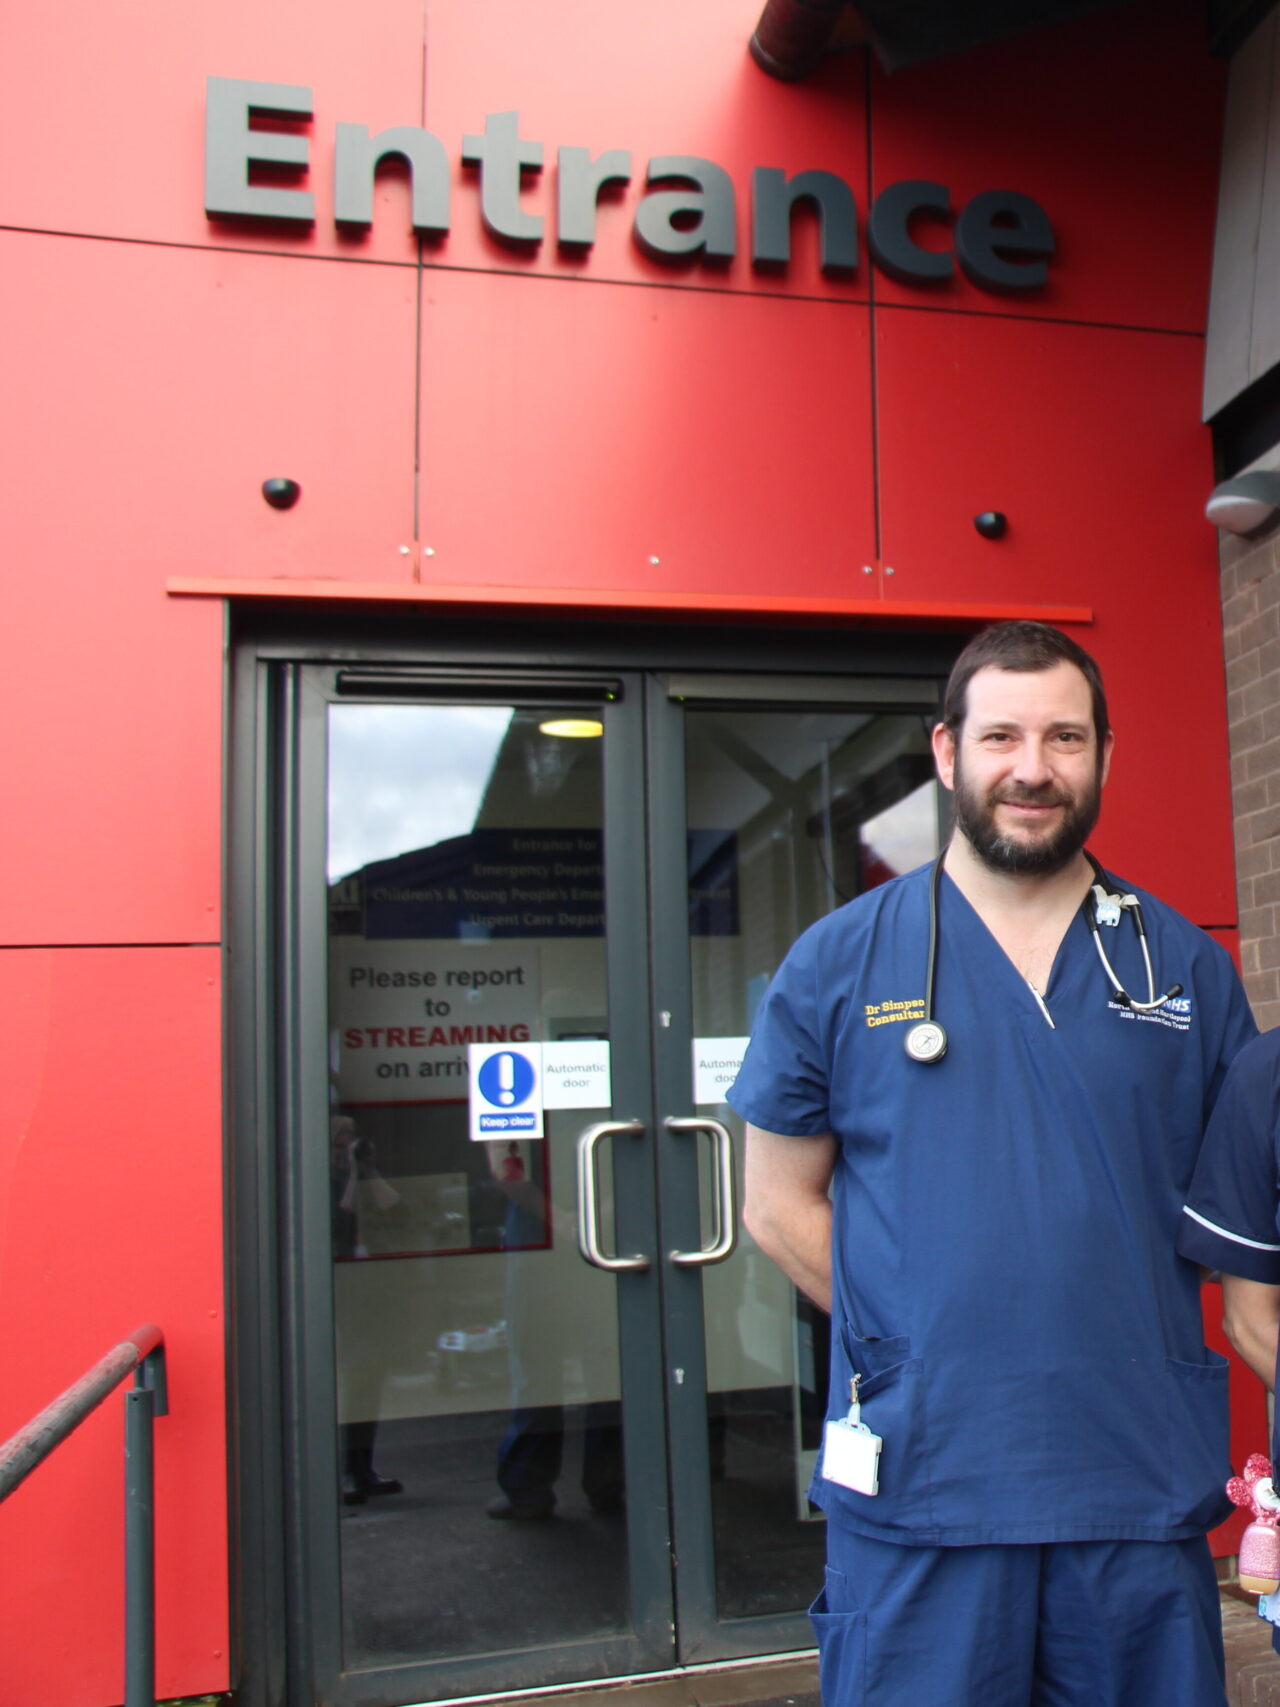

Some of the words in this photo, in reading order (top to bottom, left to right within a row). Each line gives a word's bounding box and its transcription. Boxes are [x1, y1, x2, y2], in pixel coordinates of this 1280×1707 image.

[205, 76, 1055, 292] Entrance
[473, 864, 550, 878] Emergency
[554, 863, 603, 877] Depart
[463, 889, 507, 904] Young
[572, 889, 604, 901] Eme
[470, 913, 520, 929] Urgent
[523, 913, 554, 926] Care
[558, 912, 605, 927] Depart
[351, 967, 437, 988] Please
[446, 966, 525, 990] report
[425, 999, 450, 1017] to
[865, 1005, 881, 1015] Dr
[881, 999, 925, 1012] Simpso
[1172, 1022, 1190, 1031] Trust
[344, 1024, 530, 1049] STREAMING
[377, 1062, 409, 1079] on
[546, 1063, 606, 1075] Automatic
[699, 1059, 743, 1069] Automa
[562, 1078, 590, 1088] door
[715, 1073, 736, 1083] doo
[481, 1117, 509, 1128] Keep
[510, 1116, 535, 1127] clear
